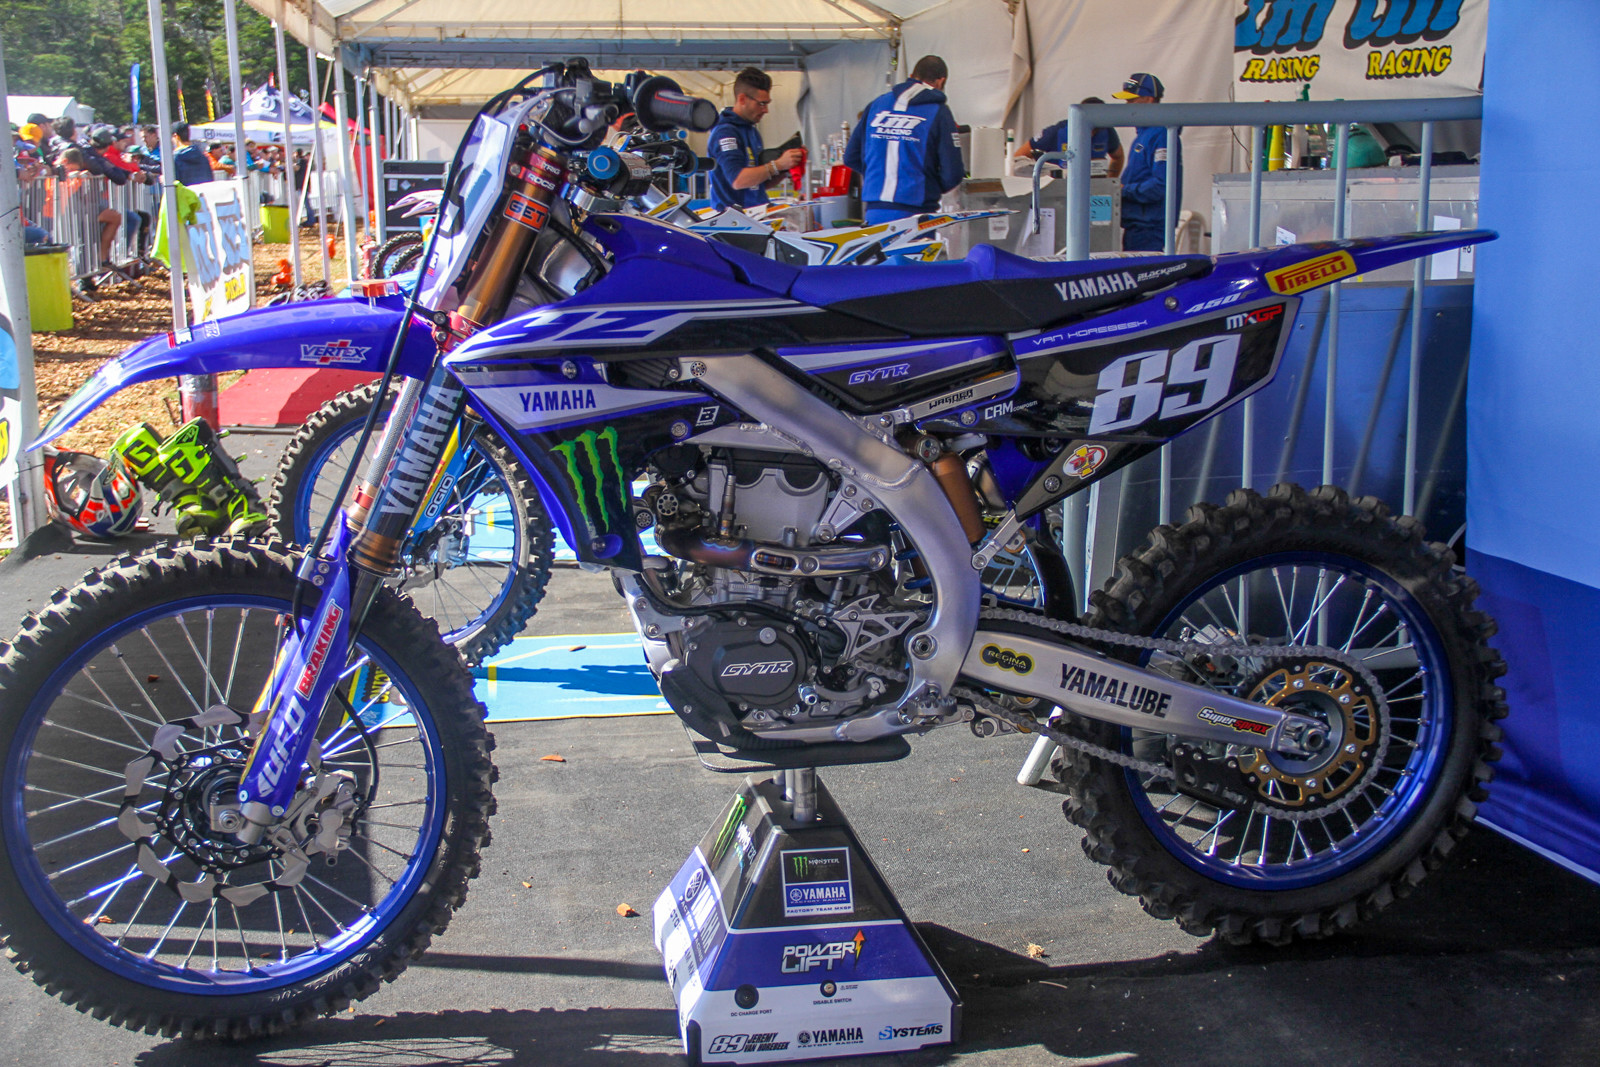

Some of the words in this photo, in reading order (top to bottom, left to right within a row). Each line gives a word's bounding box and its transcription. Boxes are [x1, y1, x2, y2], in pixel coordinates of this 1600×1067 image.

[1240, 56, 1320, 82] RACING
[1366, 46, 1452, 79] RACING
[876, 127, 912, 135] RACING
[528, 173, 555, 190] ROCS
[509, 200, 545, 223] GET
[1274, 255, 1347, 292] PIRELLI
[1054, 271, 1138, 301] YAMAHA
[1184, 288, 1258, 314] 450F
[1226, 305, 1283, 330] MXGP
[1033, 334, 1065, 346] VAN
[301, 345, 377, 361] VERTEX
[849, 363, 910, 385] GYTR
[1088, 333, 1242, 436] 89
[519, 389, 596, 412] YAMAHA
[985, 400, 1013, 420] CRM
[380, 385, 464, 516] YAMAHA
[425, 474, 456, 517] OGIO
[298, 606, 341, 695] BRAKING
[988, 650, 1026, 667] REGINA
[721, 661, 794, 677] GYTR
[1059, 663, 1171, 718] YAMALUBE
[263, 695, 306, 787] UFO
[802, 886, 846, 900] YAMAHA
[782, 941, 856, 960] POWER
[781, 955, 842, 974] LIFT
[747, 1032, 779, 1044] JEREMY
[812, 1027, 863, 1043] YAMAHA
[879, 1023, 944, 1040] SYSTEMS
[708, 1034, 749, 1054] 89
[744, 1043, 759, 1053] VAN
